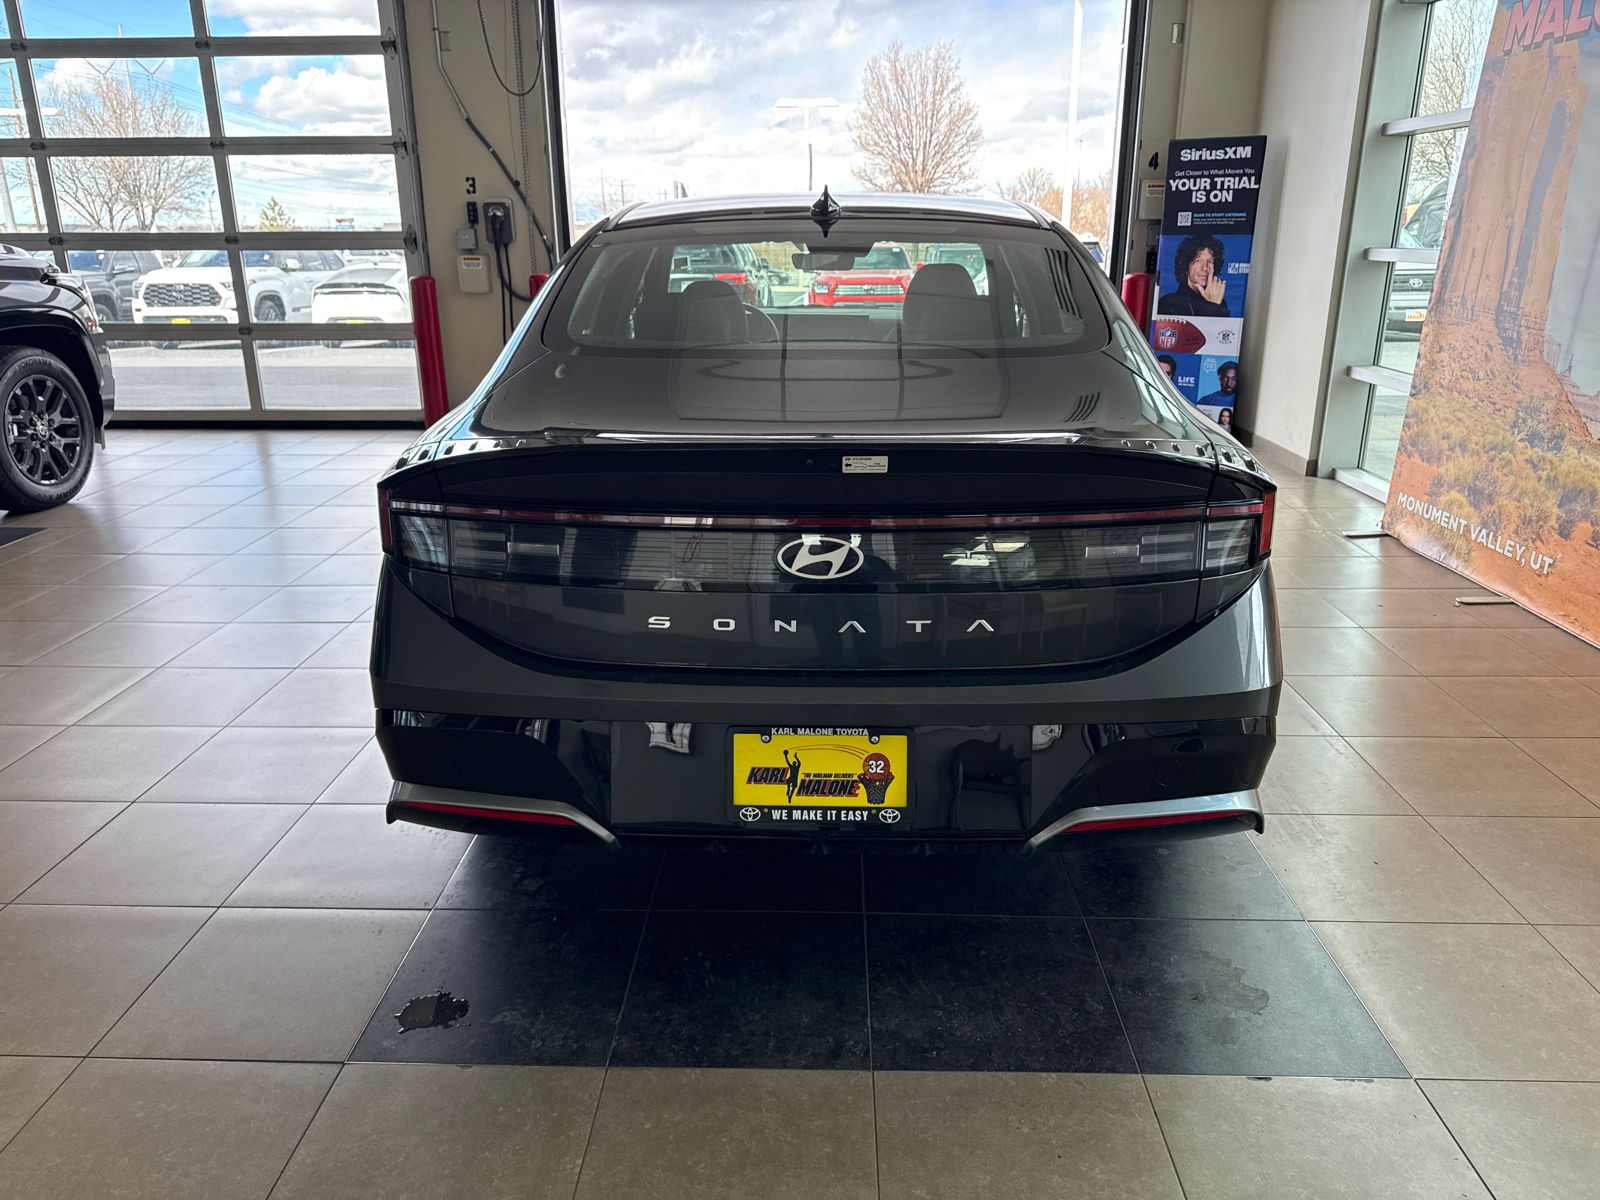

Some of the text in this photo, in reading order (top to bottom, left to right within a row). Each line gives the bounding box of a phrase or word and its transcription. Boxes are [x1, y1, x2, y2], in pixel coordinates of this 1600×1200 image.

[1180, 146, 1252, 161] SiriusXM
[1148, 152, 1159, 171] 4
[466, 177, 476, 194] 3
[1169, 178, 1210, 191] YOUR
[1214, 176, 1259, 190] TRIAL
[1192, 190, 1233, 204] IS ON
[1160, 337, 1174, 347] NFL
[16, 358, 52, 370] YOKOHAMA
[1397, 492, 1554, 575] MONUMENT VALLEY, UT
[648, 616, 995, 634] SONATA
[868, 760, 885, 774] 32
[746, 767, 789, 785] KARL
[796, 779, 860, 797] MALONE
[772, 810, 868, 821] WE MAKE IT EASY
